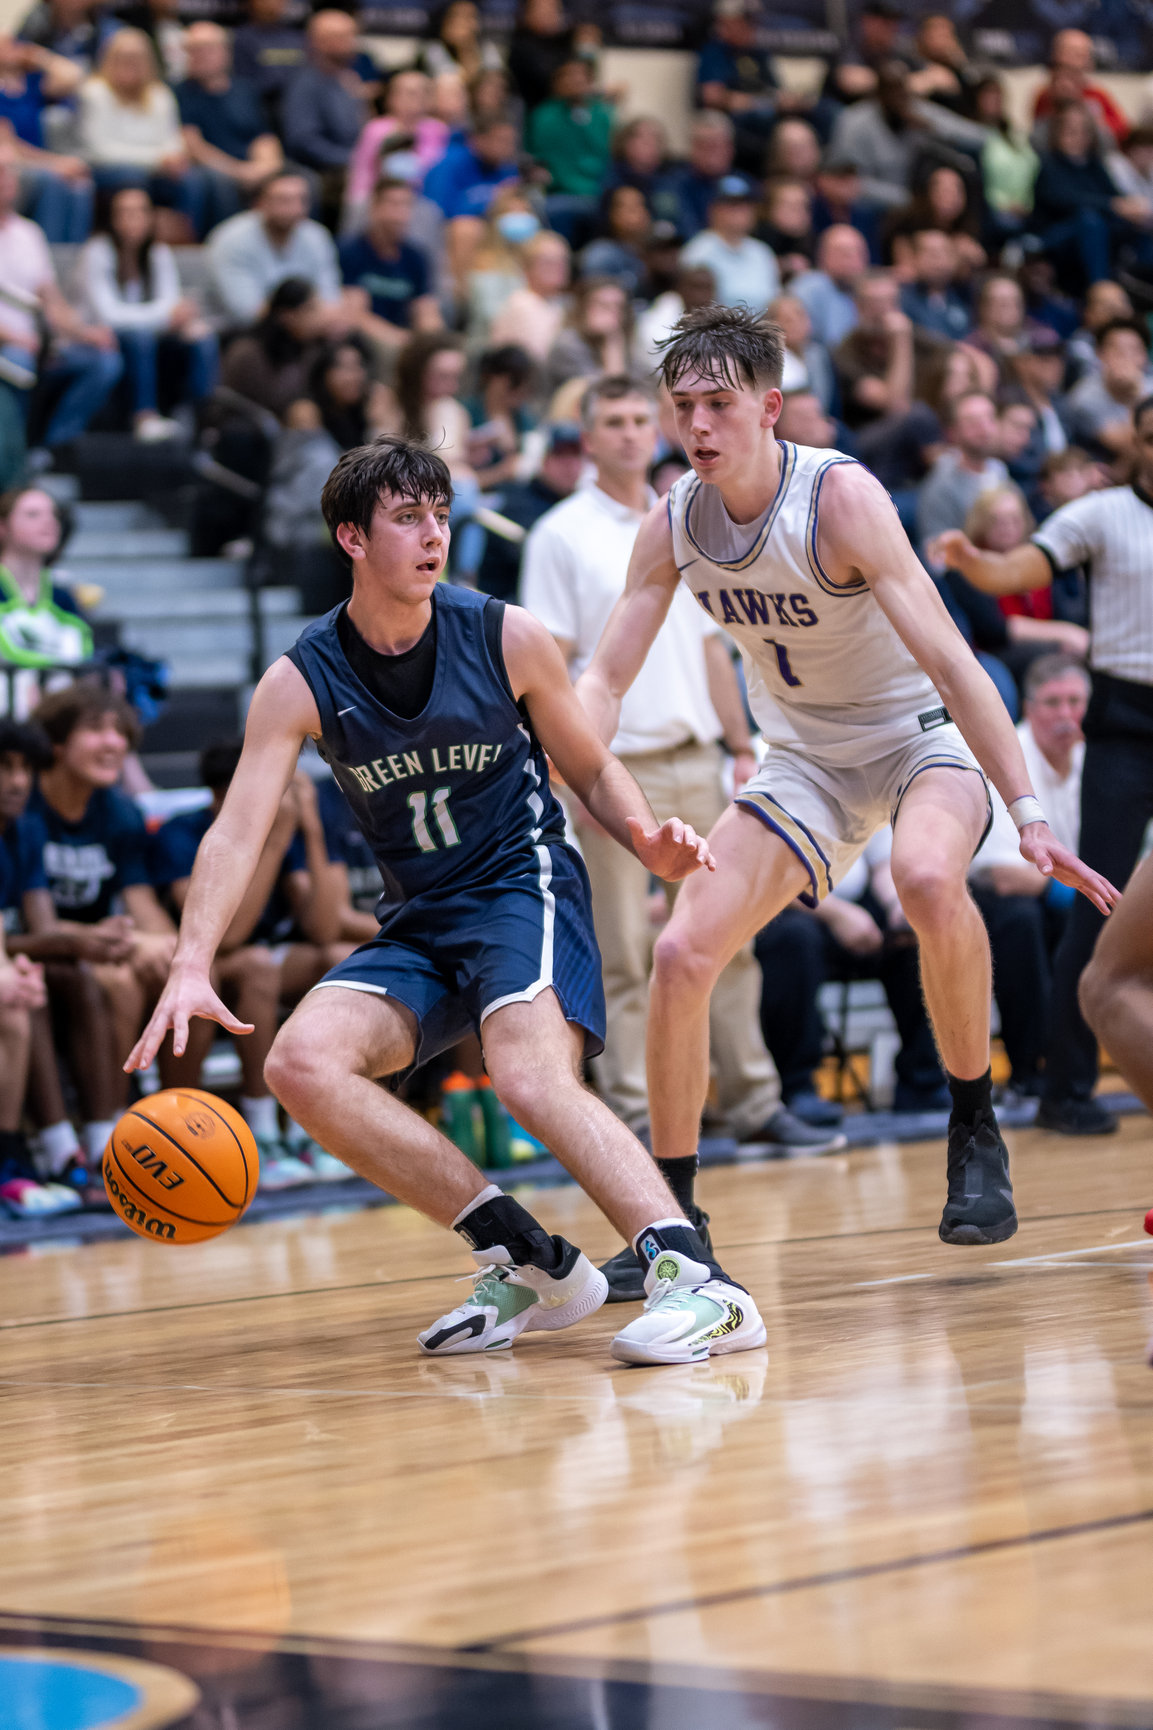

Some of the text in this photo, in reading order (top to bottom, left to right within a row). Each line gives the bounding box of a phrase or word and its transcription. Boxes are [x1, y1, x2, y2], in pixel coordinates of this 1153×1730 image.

[762, 636, 803, 688] 1
[349, 750, 424, 793] REEN
[406, 786, 462, 854] 11
[130, 1143, 185, 1191] EVO
[104, 1159, 177, 1240] Wilson
